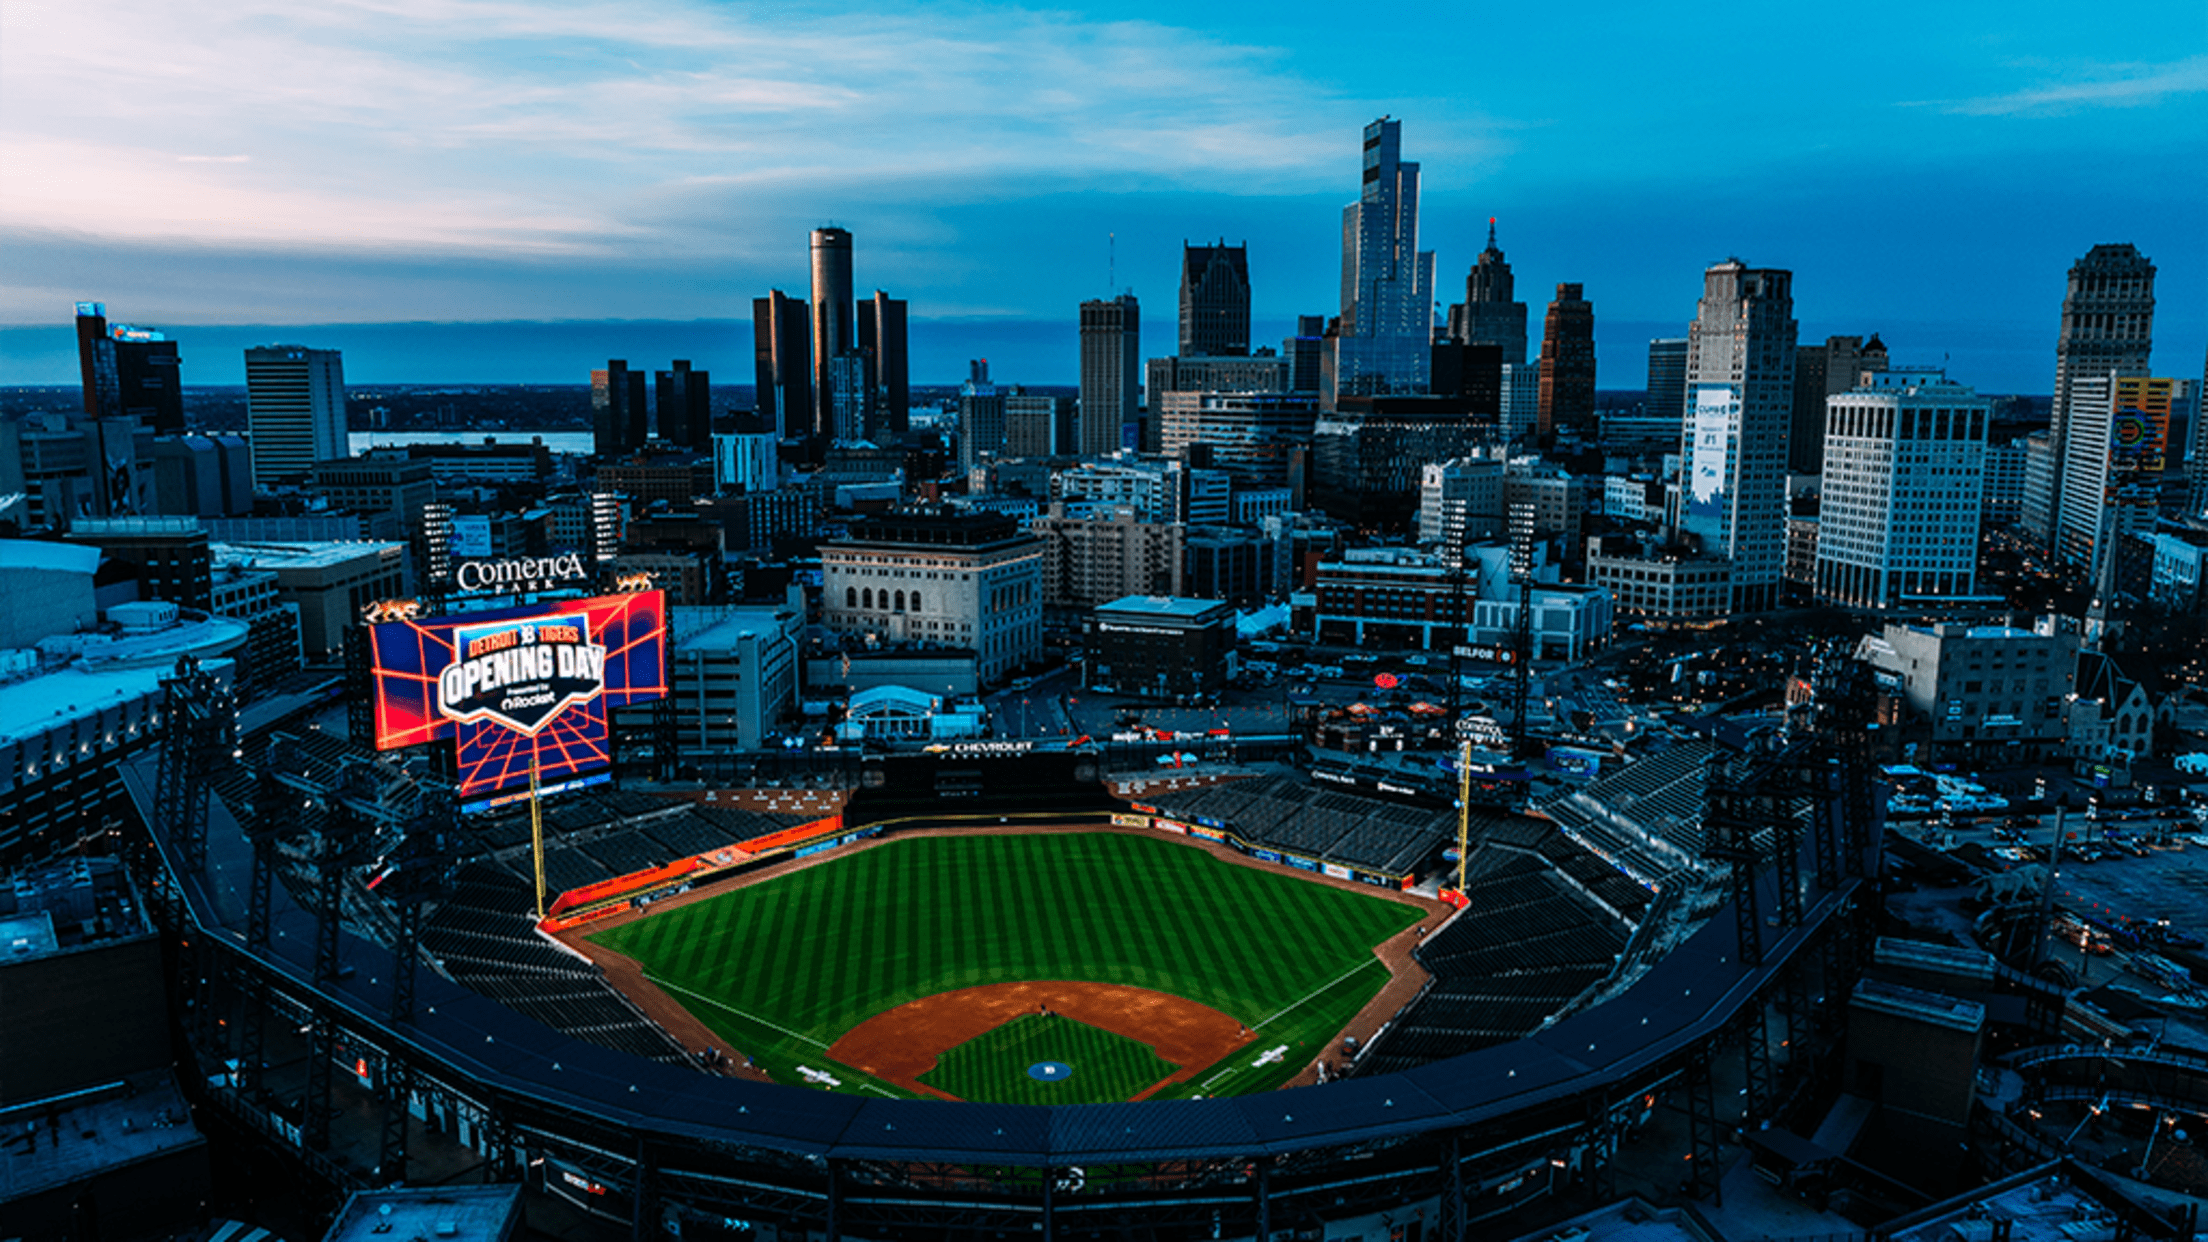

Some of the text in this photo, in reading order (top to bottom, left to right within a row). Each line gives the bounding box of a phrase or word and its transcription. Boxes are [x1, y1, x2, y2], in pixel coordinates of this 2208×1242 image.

[495, 580, 554, 594] PARK
[469, 629, 518, 659] DETROIT
[539, 626, 579, 643] TIGERS
[1453, 645, 1494, 660] BELFOR
[445, 644, 603, 706] OPENING DAY
[954, 741, 1033, 752] CHEVROLET
